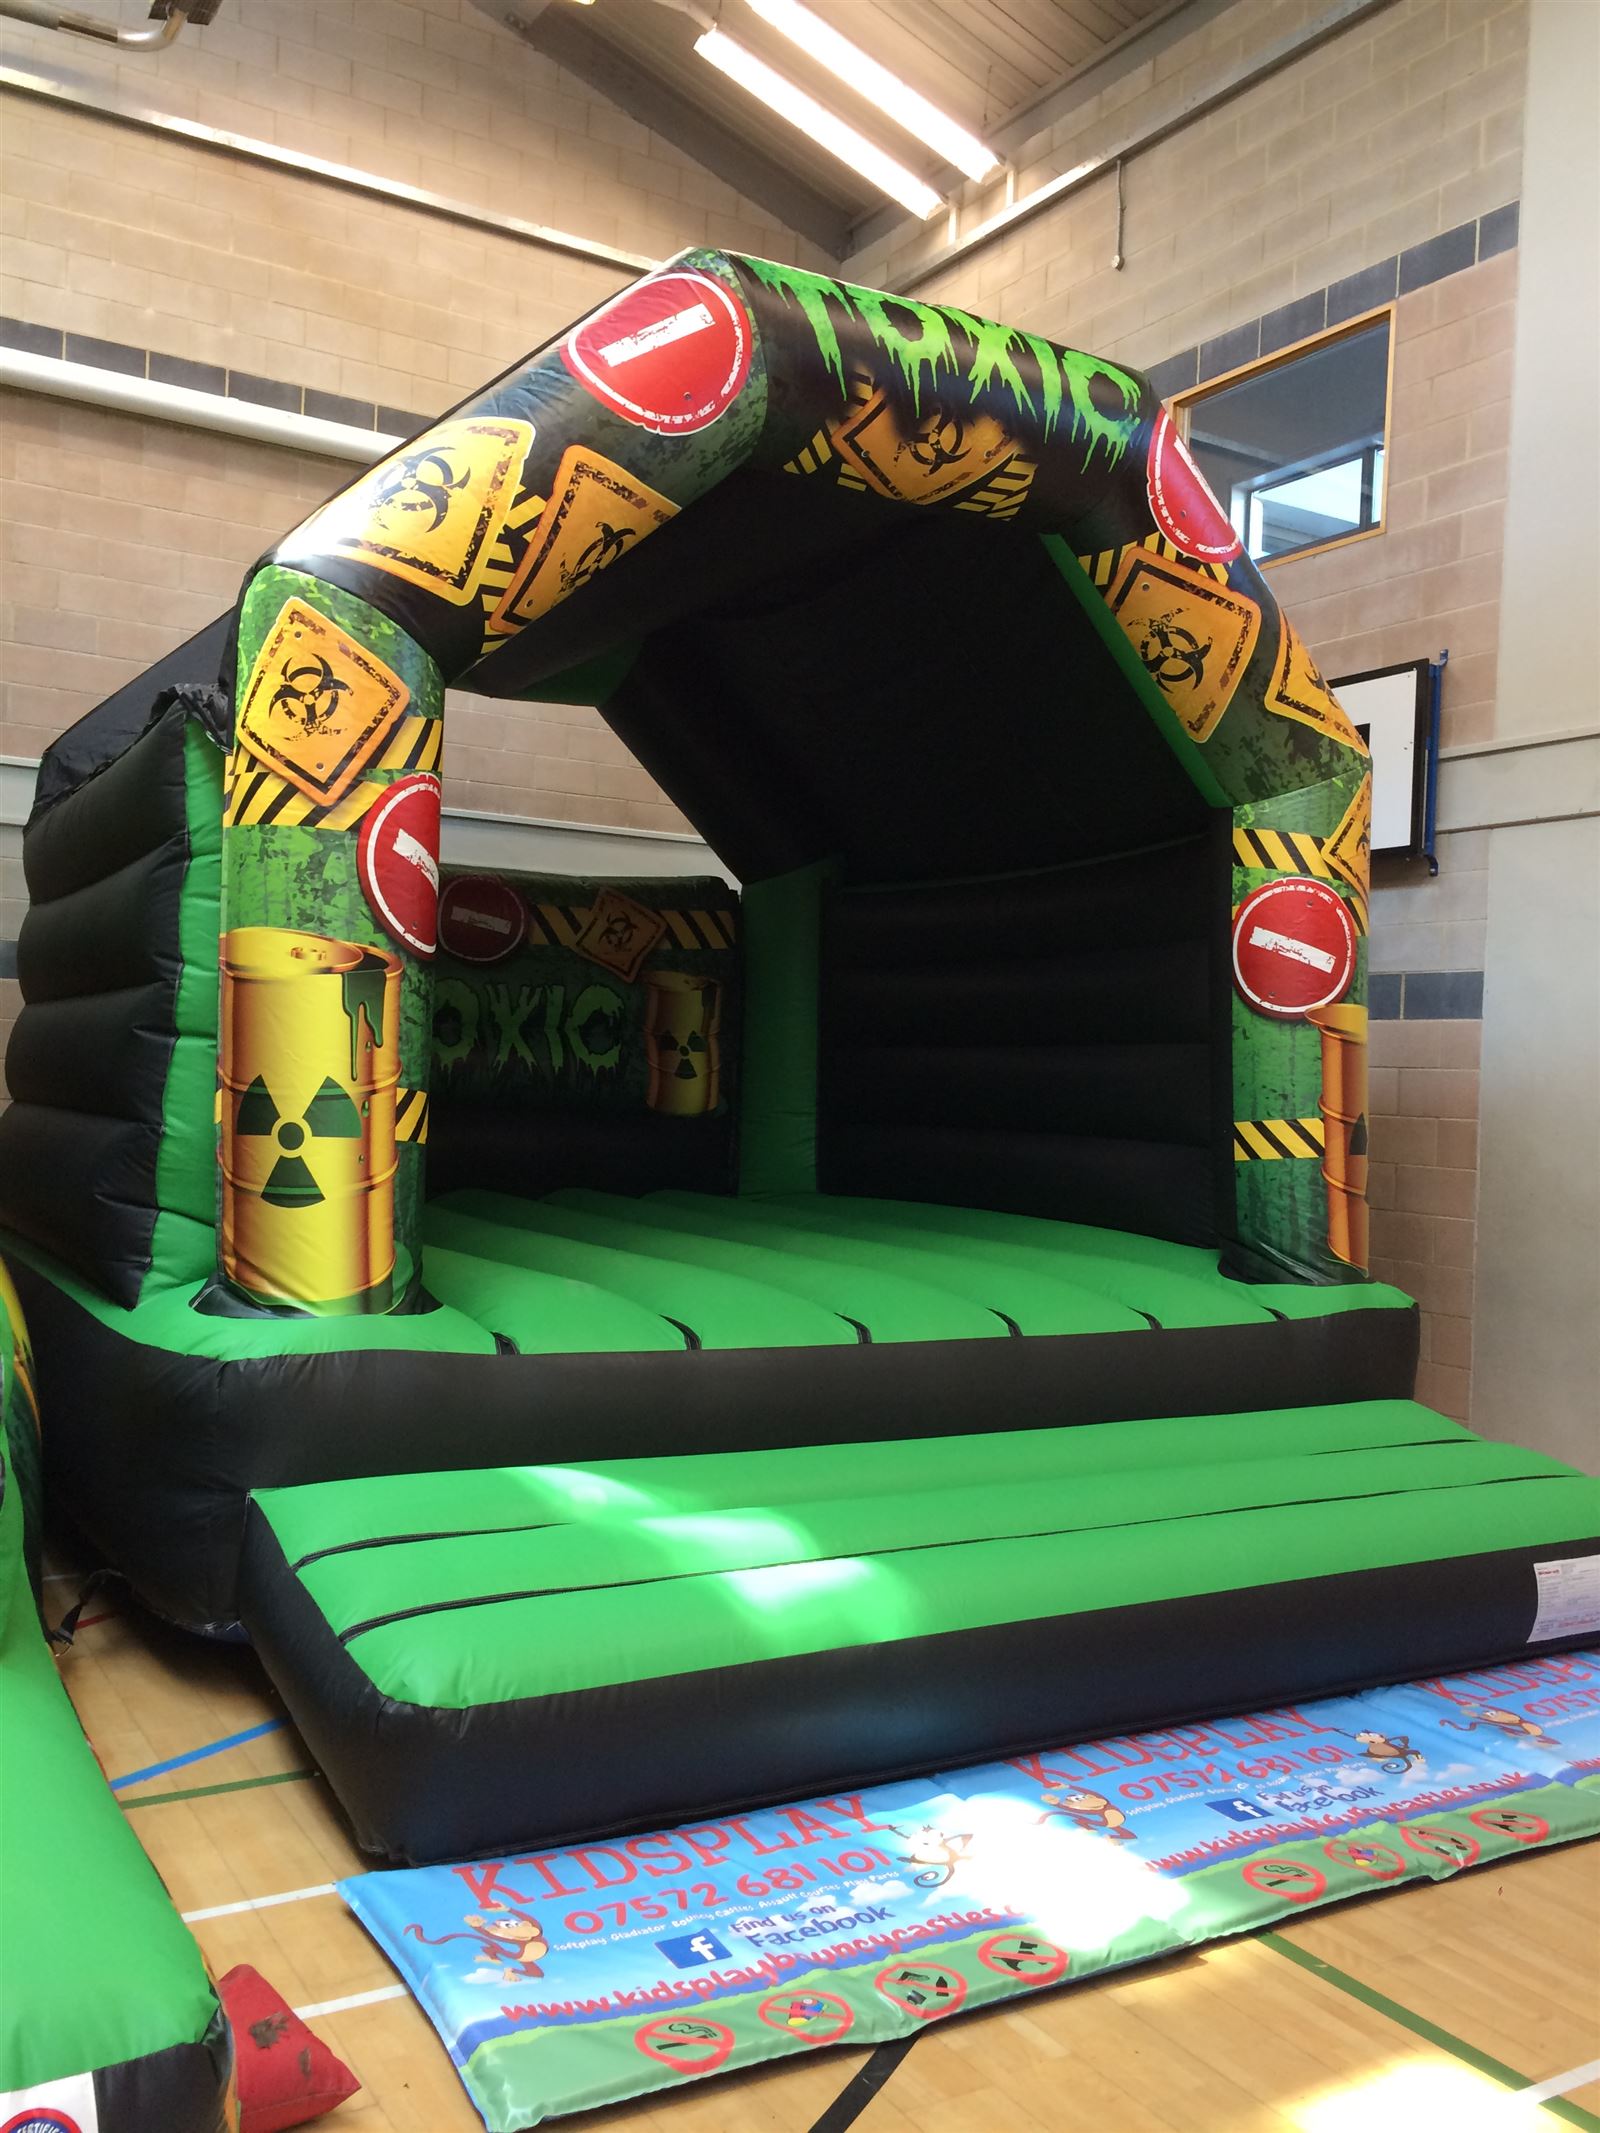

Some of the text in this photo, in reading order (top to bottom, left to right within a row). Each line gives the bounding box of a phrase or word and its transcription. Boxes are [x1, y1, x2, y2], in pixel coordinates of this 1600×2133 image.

[740, 252, 1142, 475] TOXIC
[451, 1794, 890, 1909] KIDSPLAY
[563, 1847, 892, 1935] 07572 681 101
[553, 1935, 608, 1951] Softplay
[610, 1924, 667, 1941] Gladiator
[757, 1892, 799, 1909] Assault
[868, 1870, 900, 1884] Parks
[729, 1903, 837, 1934] Find us on
[746, 1904, 897, 1948] Facebook
